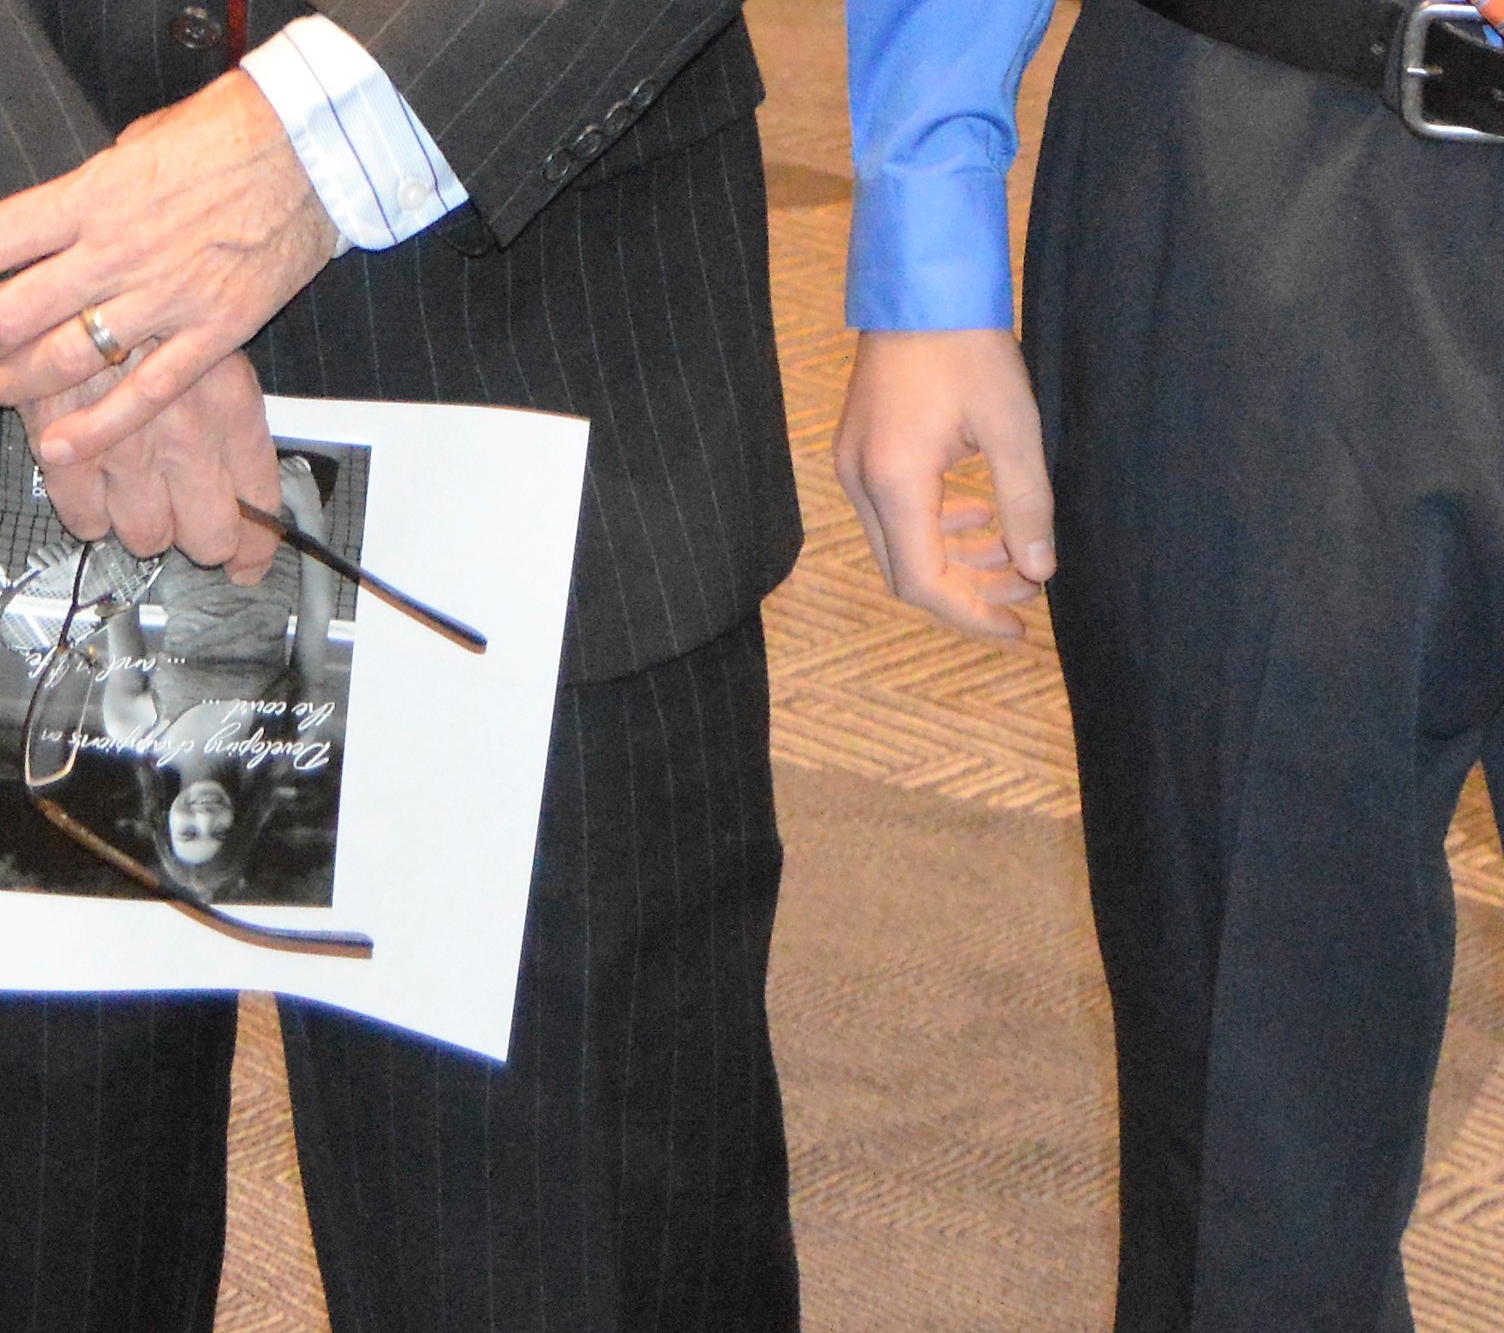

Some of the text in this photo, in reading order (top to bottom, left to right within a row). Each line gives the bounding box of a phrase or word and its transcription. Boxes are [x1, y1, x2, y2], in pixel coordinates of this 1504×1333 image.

[94, 655, 157, 682] and
[222, 699, 287, 723] court
[294, 701, 336, 731] the
[69, 725, 195, 768] champions
[204, 722, 331, 771] Developing
